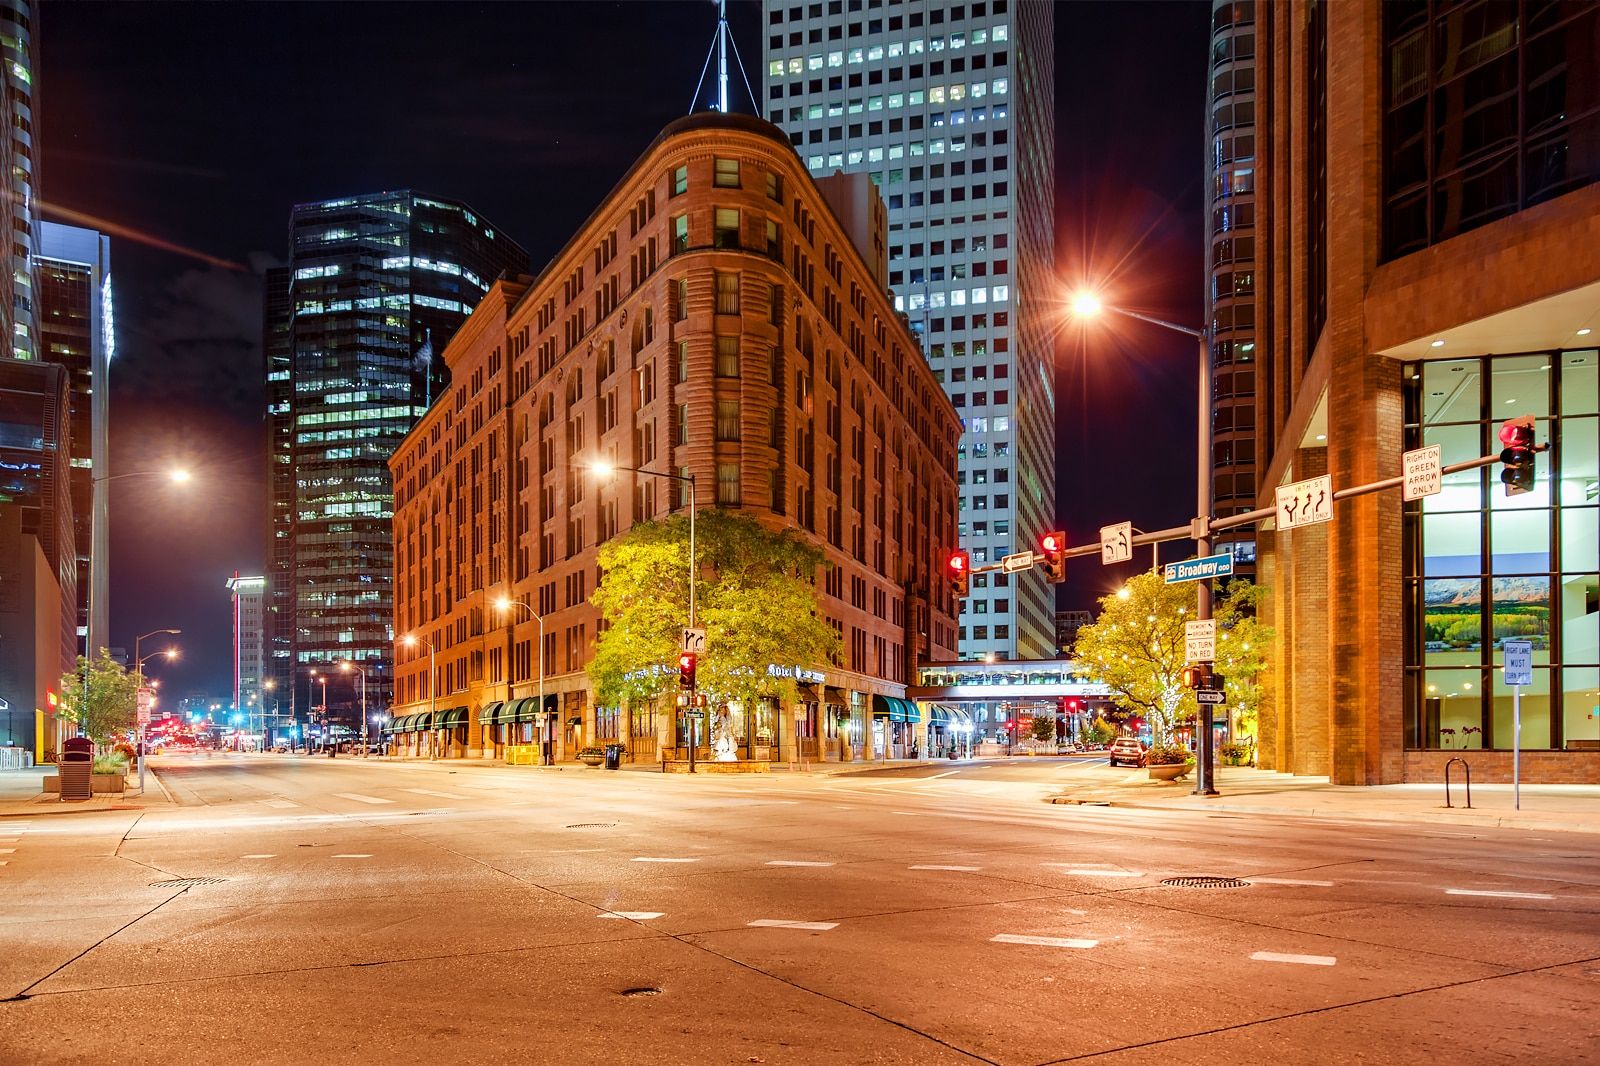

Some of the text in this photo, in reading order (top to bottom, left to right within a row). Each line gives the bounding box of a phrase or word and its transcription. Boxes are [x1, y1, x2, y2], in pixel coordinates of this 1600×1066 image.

[1406, 450, 1438, 463] RIGHT ON
[1410, 462, 1436, 473] GREEN
[1314, 480, 1323, 488] ST
[1409, 473, 1437, 485] ARROW
[1412, 484, 1434, 495] ONLY
[1178, 562, 1218, 578] Broadway
[1198, 641, 1213, 649] TURN
[1190, 650, 1211, 659] ON RED
[1506, 646, 1530, 655] RIGHT LANE
[1510, 659, 1525, 668] MUST
